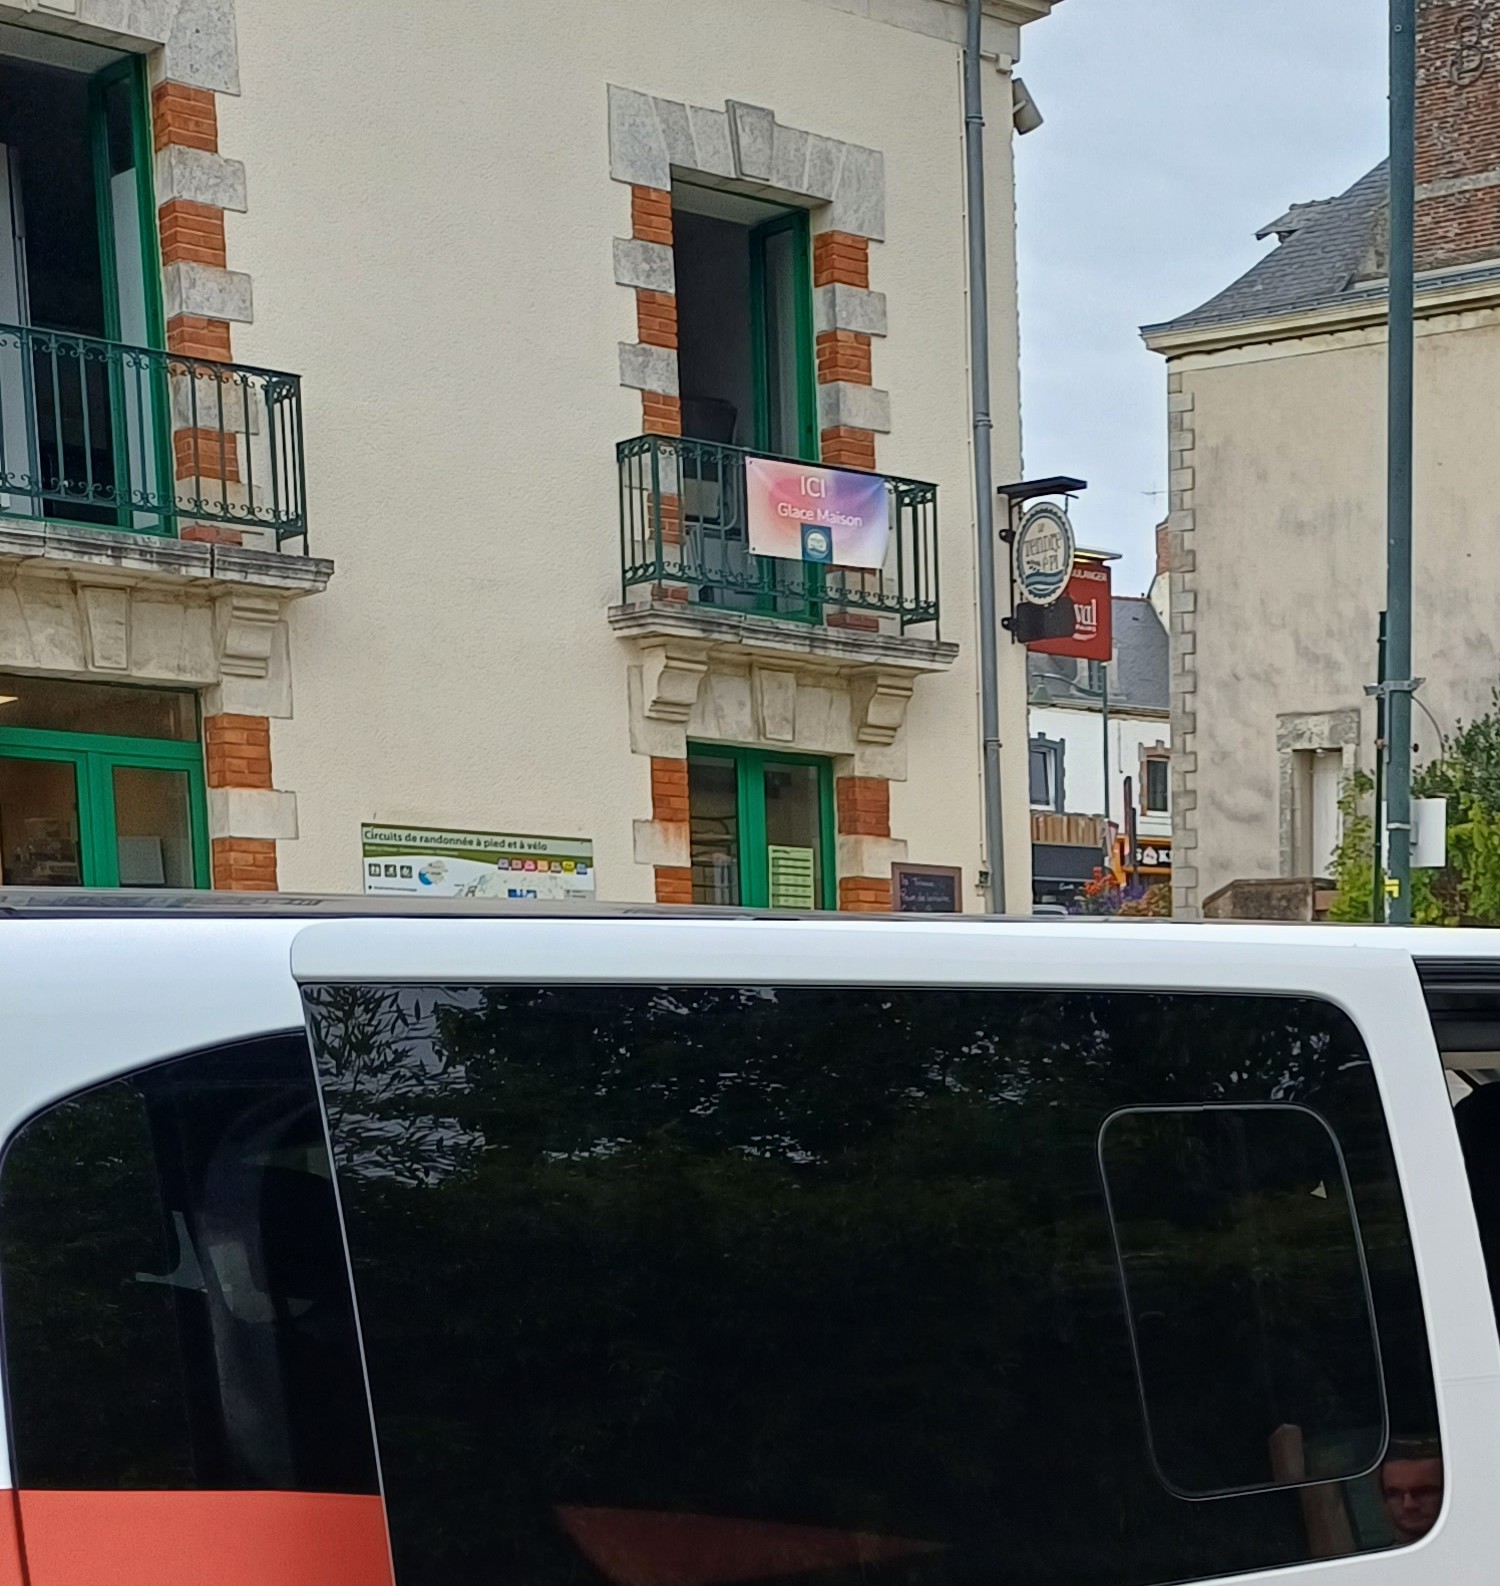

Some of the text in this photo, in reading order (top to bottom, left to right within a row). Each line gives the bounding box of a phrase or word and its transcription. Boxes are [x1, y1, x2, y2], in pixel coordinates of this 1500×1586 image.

[800, 475, 827, 499] ICI
[777, 502, 863, 528] Glace Maison
[364, 828, 548, 851] Circuits de randonnée à pied et à vélo
